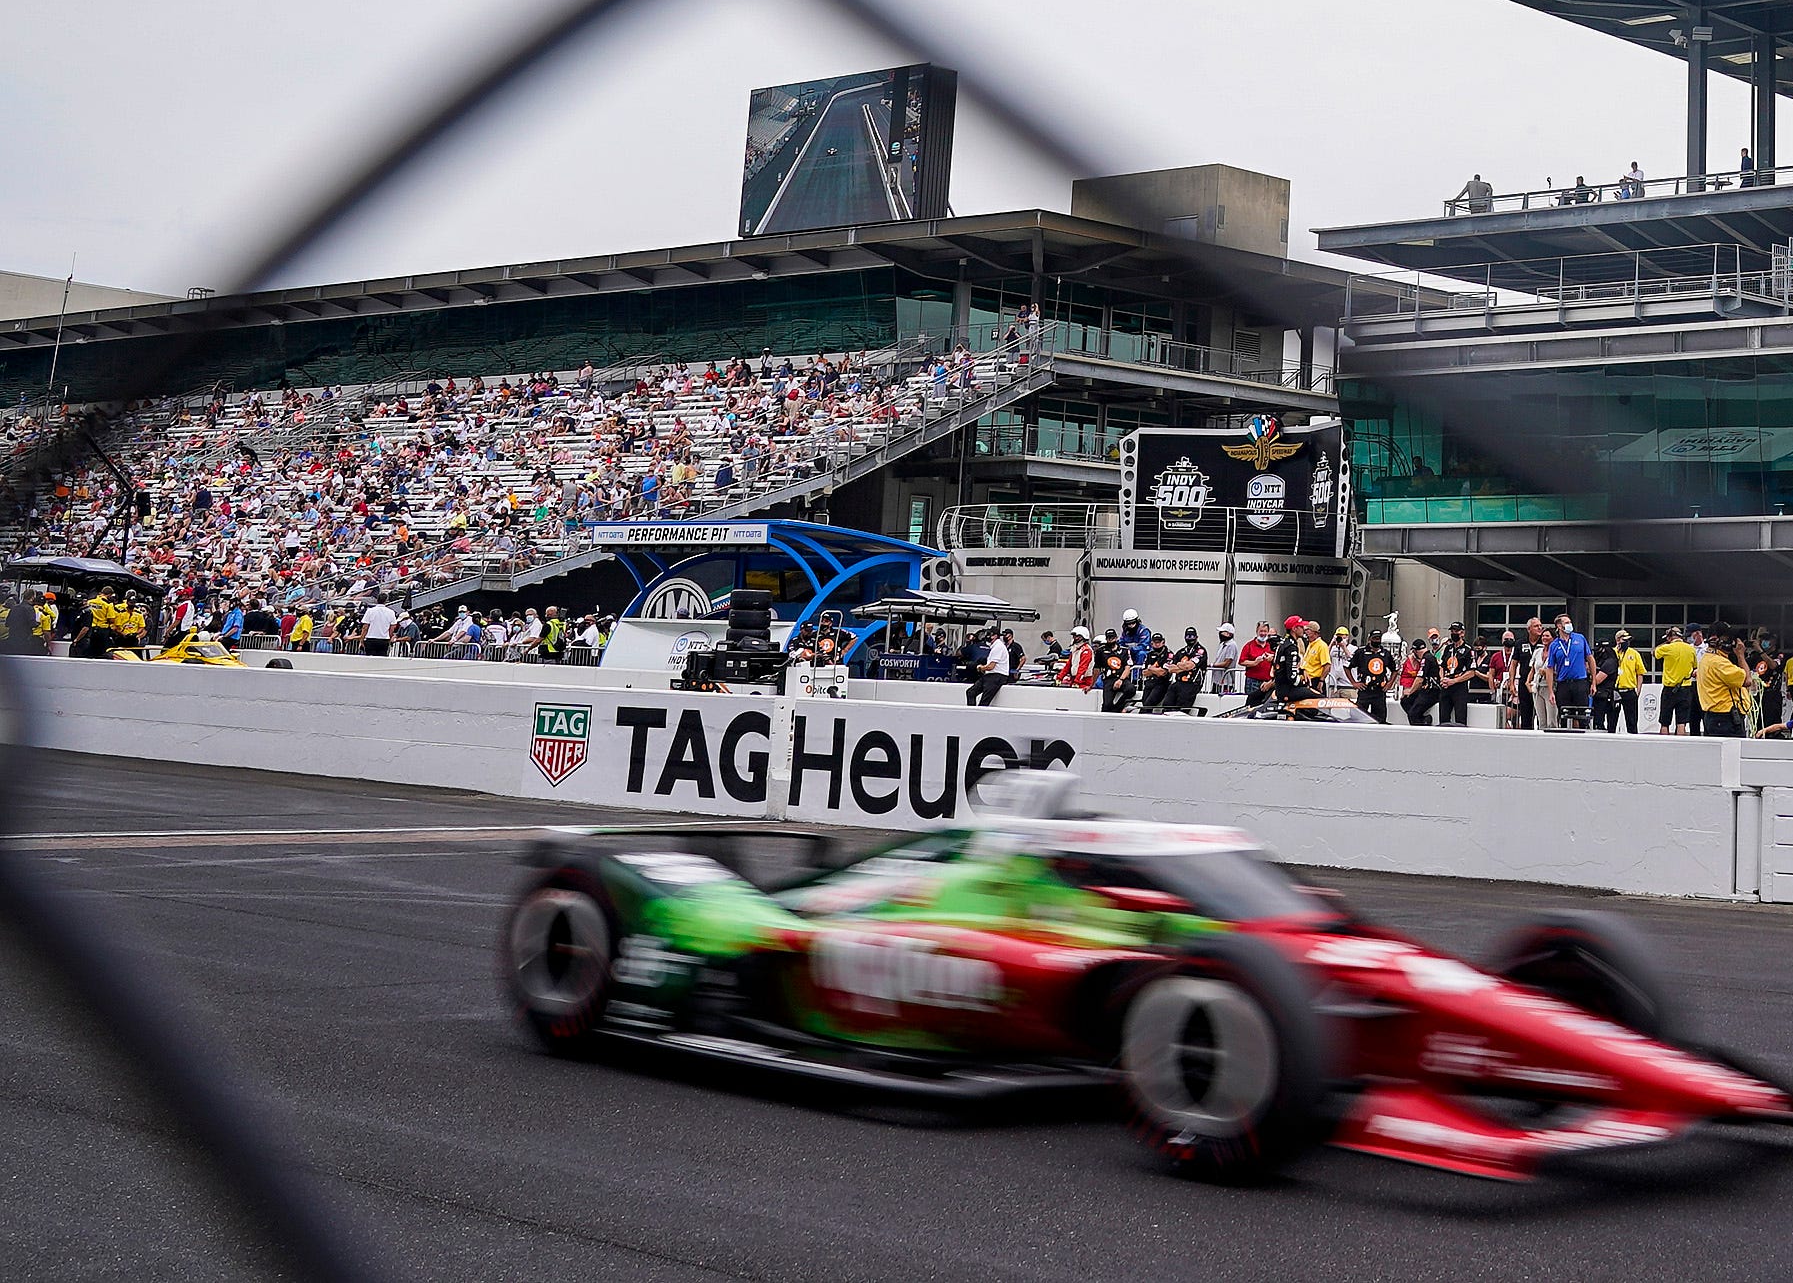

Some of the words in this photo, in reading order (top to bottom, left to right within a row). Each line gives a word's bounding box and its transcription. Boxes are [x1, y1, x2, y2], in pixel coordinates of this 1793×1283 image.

[1166, 474, 1197, 486] INDY
[1156, 485, 1206, 506] 500
[1264, 484, 1281, 493] NTT
[1312, 481, 1332, 505] 500
[1246, 499, 1285, 509] INDYCAR
[627, 528, 709, 541] PERFORMANCE
[711, 527, 730, 541] PIT
[1096, 557, 1148, 570] INDIANAPOLIS
[1149, 559, 1177, 571] MOTOR
[1178, 560, 1220, 572] SPEEDWAY
[1238, 562, 1289, 574] INDIANAPOLIS
[1289, 564, 1314, 575] MOTOR
[880, 658, 920, 668] COSWORTH
[540, 710, 584, 735] TAG
[534, 740, 584, 778] HEUER
